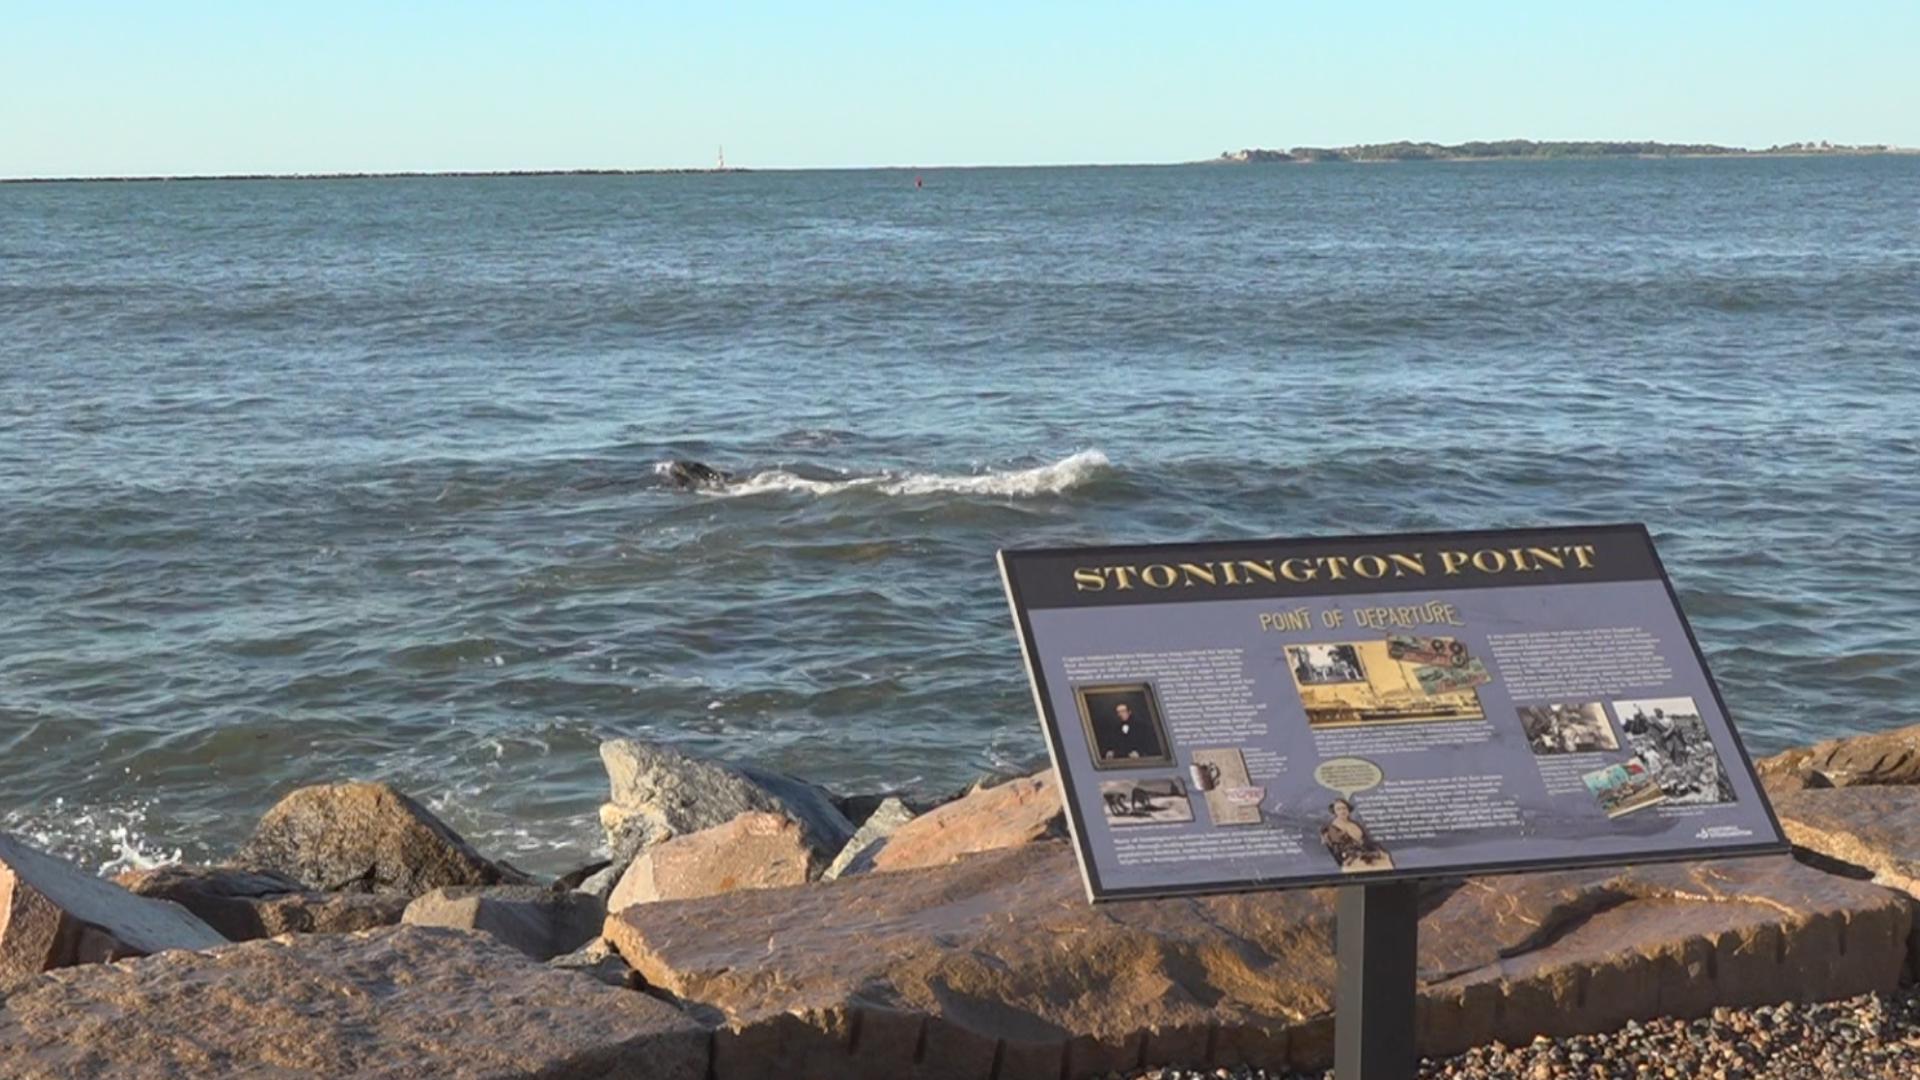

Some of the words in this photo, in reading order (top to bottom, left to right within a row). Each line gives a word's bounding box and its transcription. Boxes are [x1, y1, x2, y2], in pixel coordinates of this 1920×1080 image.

[1073, 552, 1425, 592] STONINGTON
[1438, 544, 1596, 576] POINT
[1259, 606, 1313, 632] POINT
[1321, 608, 1344, 629] OF
[1353, 600, 1465, 631] DEPARTURE
